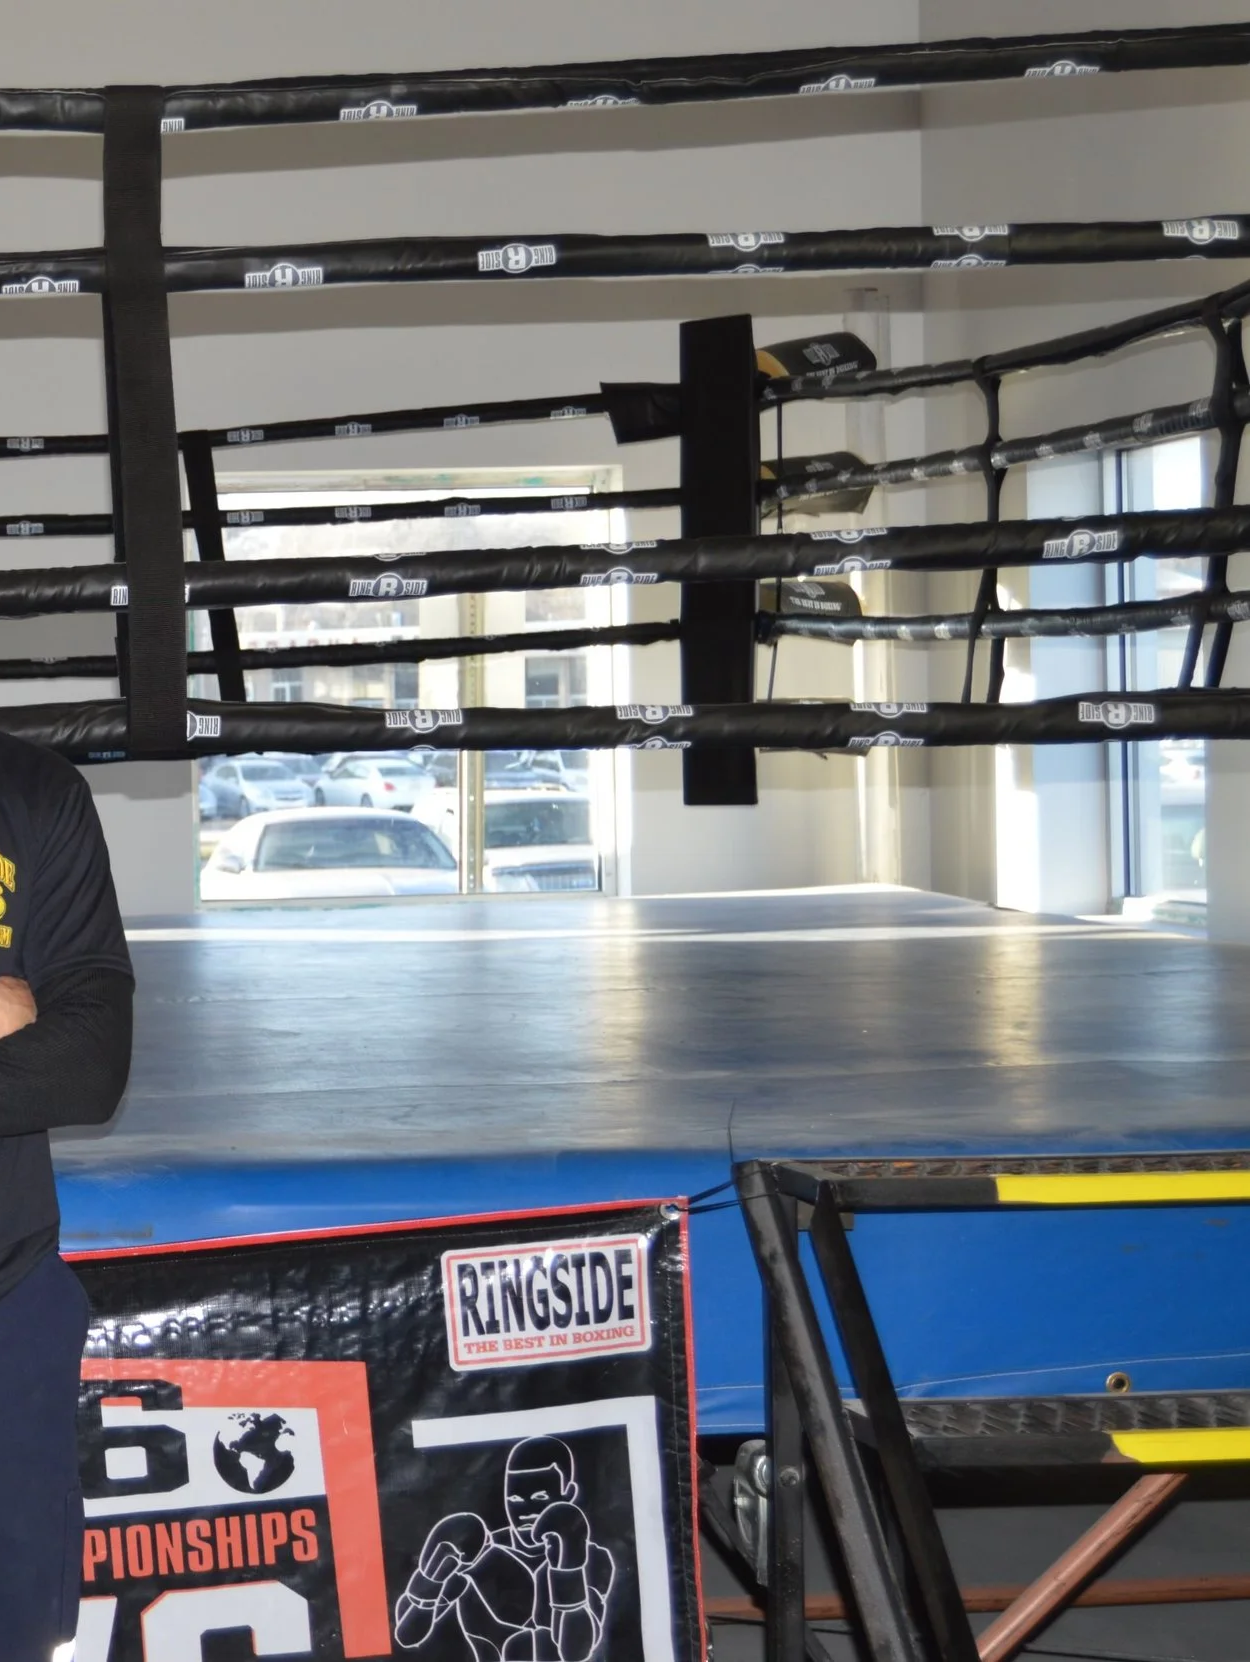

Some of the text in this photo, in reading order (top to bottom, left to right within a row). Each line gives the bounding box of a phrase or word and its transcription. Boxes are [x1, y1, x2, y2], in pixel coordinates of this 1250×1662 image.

[480, 247, 554, 270] RING R SIDE
[301, 269, 321, 285] RING
[1044, 532, 1118, 557] RING R SIDE
[350, 577, 426, 596] RING R SIDE
[387, 711, 407, 726] SIDE
[414, 709, 433, 729] R
[1080, 703, 1153, 725] RING R SIDE
[198, 717, 219, 737] RING
[457, 1249, 635, 1337] RINGSIDE
[464, 1325, 635, 1354] THE BEST IN BOXING
[83, 1508, 319, 1582] PIONSHIPS
